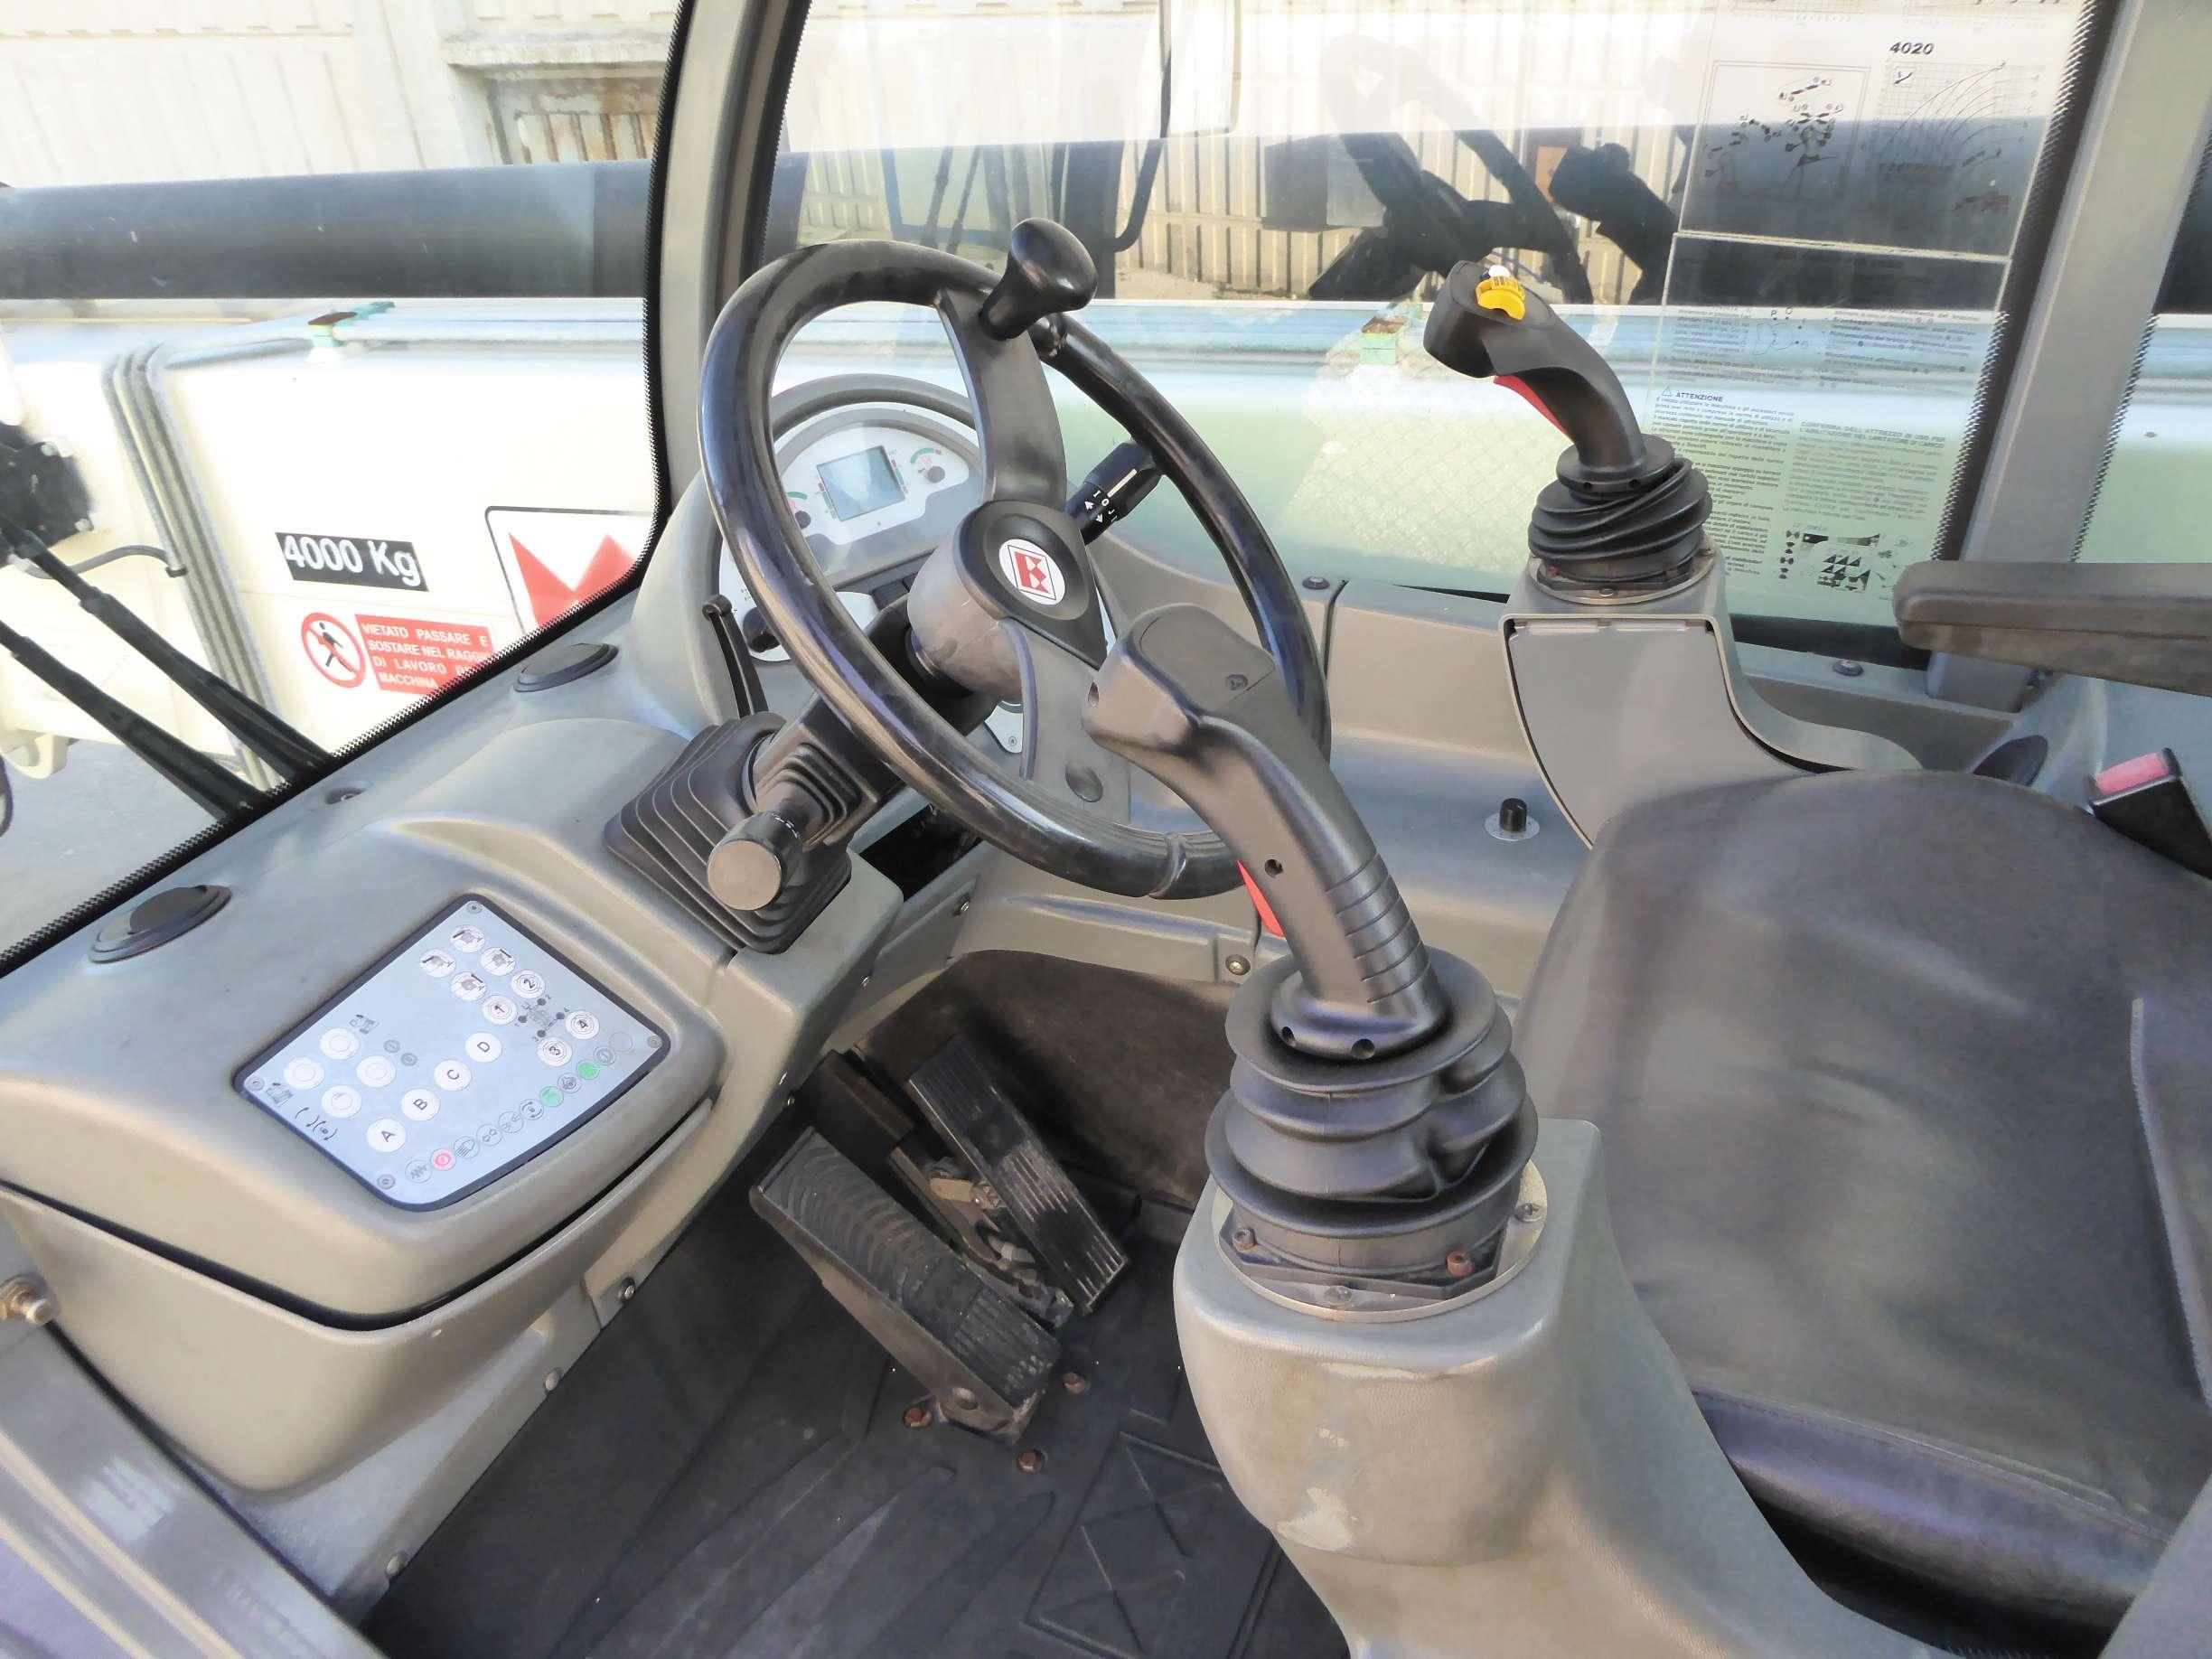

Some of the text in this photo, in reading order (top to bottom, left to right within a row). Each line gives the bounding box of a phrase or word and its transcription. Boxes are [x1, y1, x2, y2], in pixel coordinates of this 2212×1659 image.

[1889, 42, 1934, 55] 4020
[1675, 392, 1723, 402] ATTENZIONE
[284, 535, 421, 586] 4000 Kg
[361, 623, 490, 647] VIETATO PASSARE E
[368, 640, 421, 656] SOSTARE
[422, 645, 446, 659] NEL
[372, 656, 387, 667] DI
[394, 659, 448, 674] LAVORO
[378, 671, 439, 689] MACCHINA
[524, 979, 536, 989] 2
[578, 1018, 589, 1028] 4
[477, 1042, 491, 1053] D
[548, 1045, 561, 1055] 3
[446, 1069, 460, 1080] C
[413, 1098, 428, 1111] B
[381, 1130, 396, 1143] A
